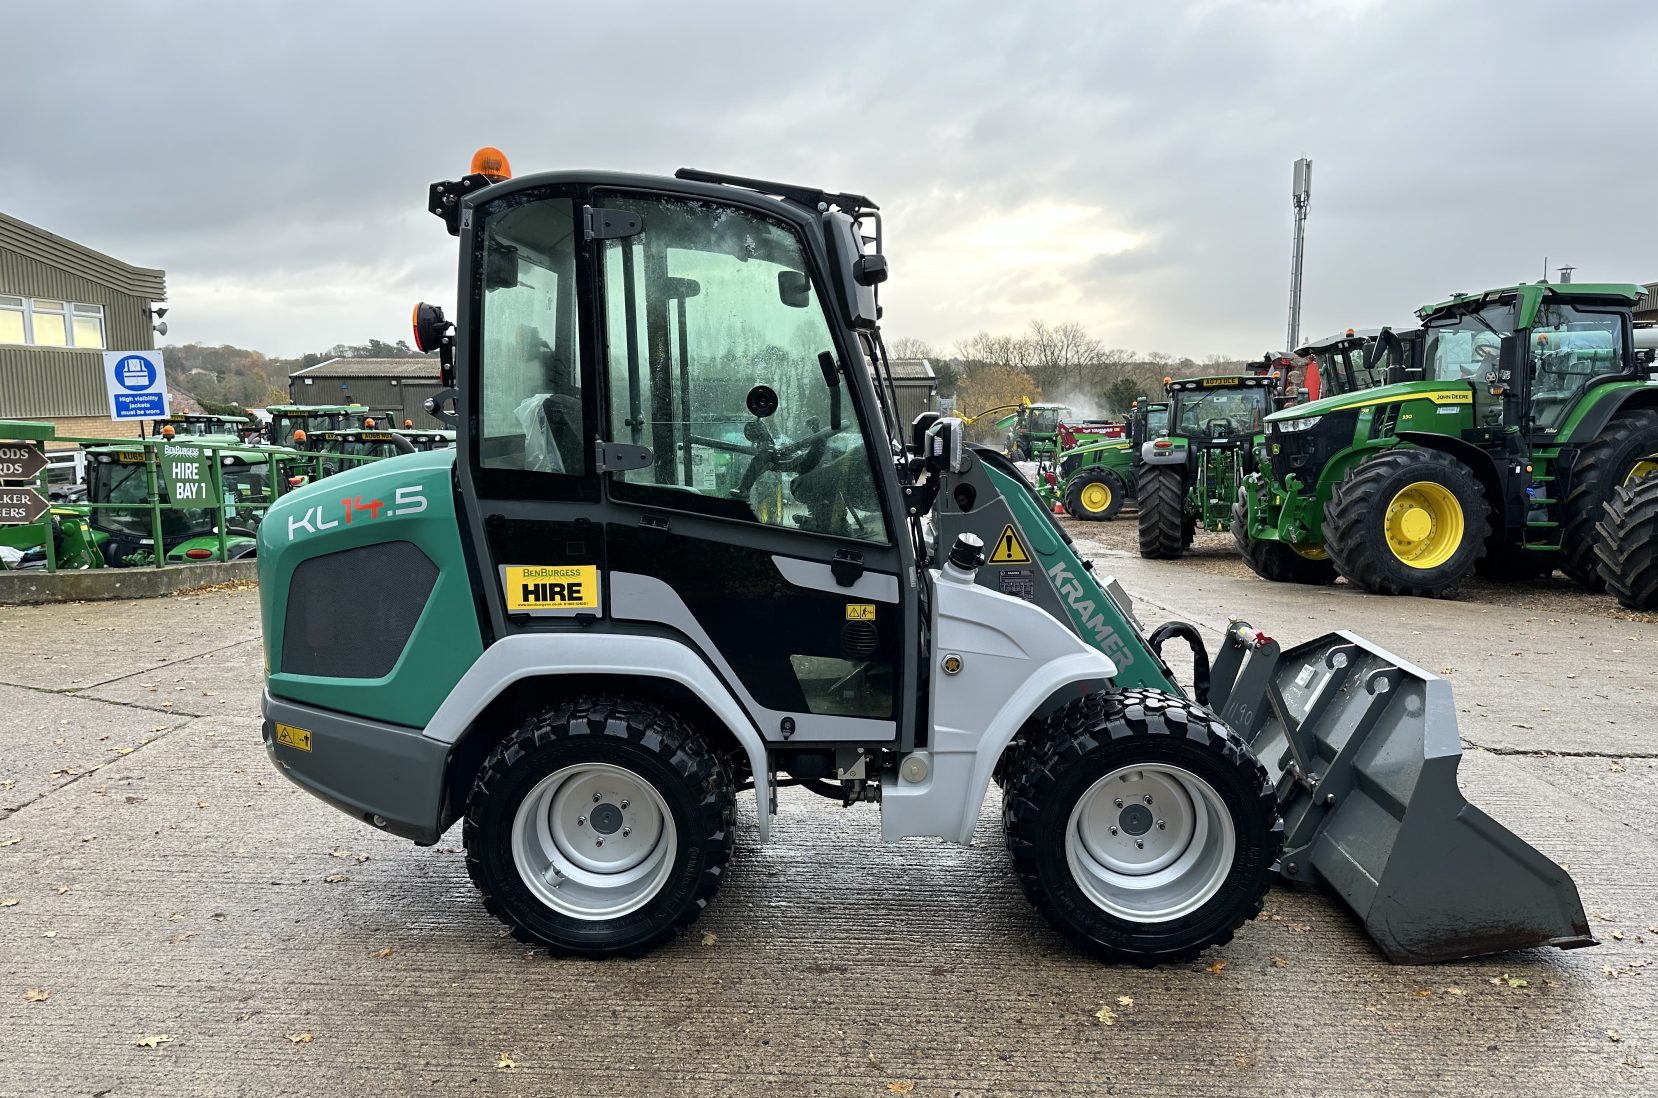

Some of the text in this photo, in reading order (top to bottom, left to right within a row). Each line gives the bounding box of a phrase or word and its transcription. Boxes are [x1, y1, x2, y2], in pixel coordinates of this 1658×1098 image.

[129, 402, 151, 410] jackets
[172, 462, 199, 479] HIRE
[176, 482, 206, 499] BAY 1
[522, 582, 583, 602] HIRE
[1048, 561, 1134, 673] KRAMER
